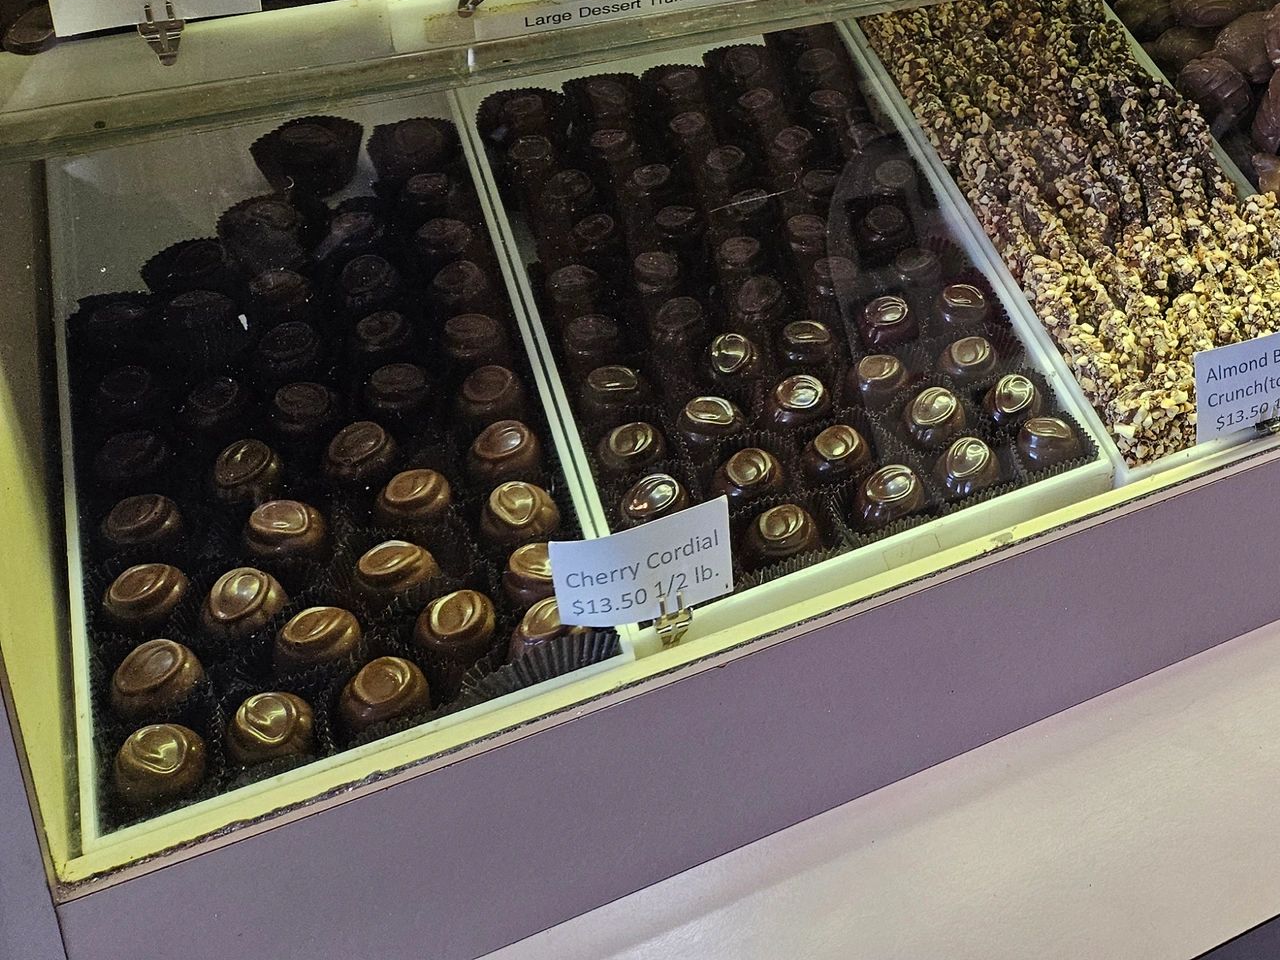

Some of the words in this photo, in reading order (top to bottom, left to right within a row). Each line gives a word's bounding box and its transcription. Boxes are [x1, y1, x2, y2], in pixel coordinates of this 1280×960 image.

[525, 10, 572, 27] Large
[1206, 352, 1268, 383] Almond
[1216, 402, 1269, 431] $13.50
[566, 561, 640, 589] Cherry
[646, 528, 719, 570] Cordial
[572, 588, 648, 616] $13.50
[654, 572, 689, 599] 1/2
[695, 564, 720, 585] lb.
